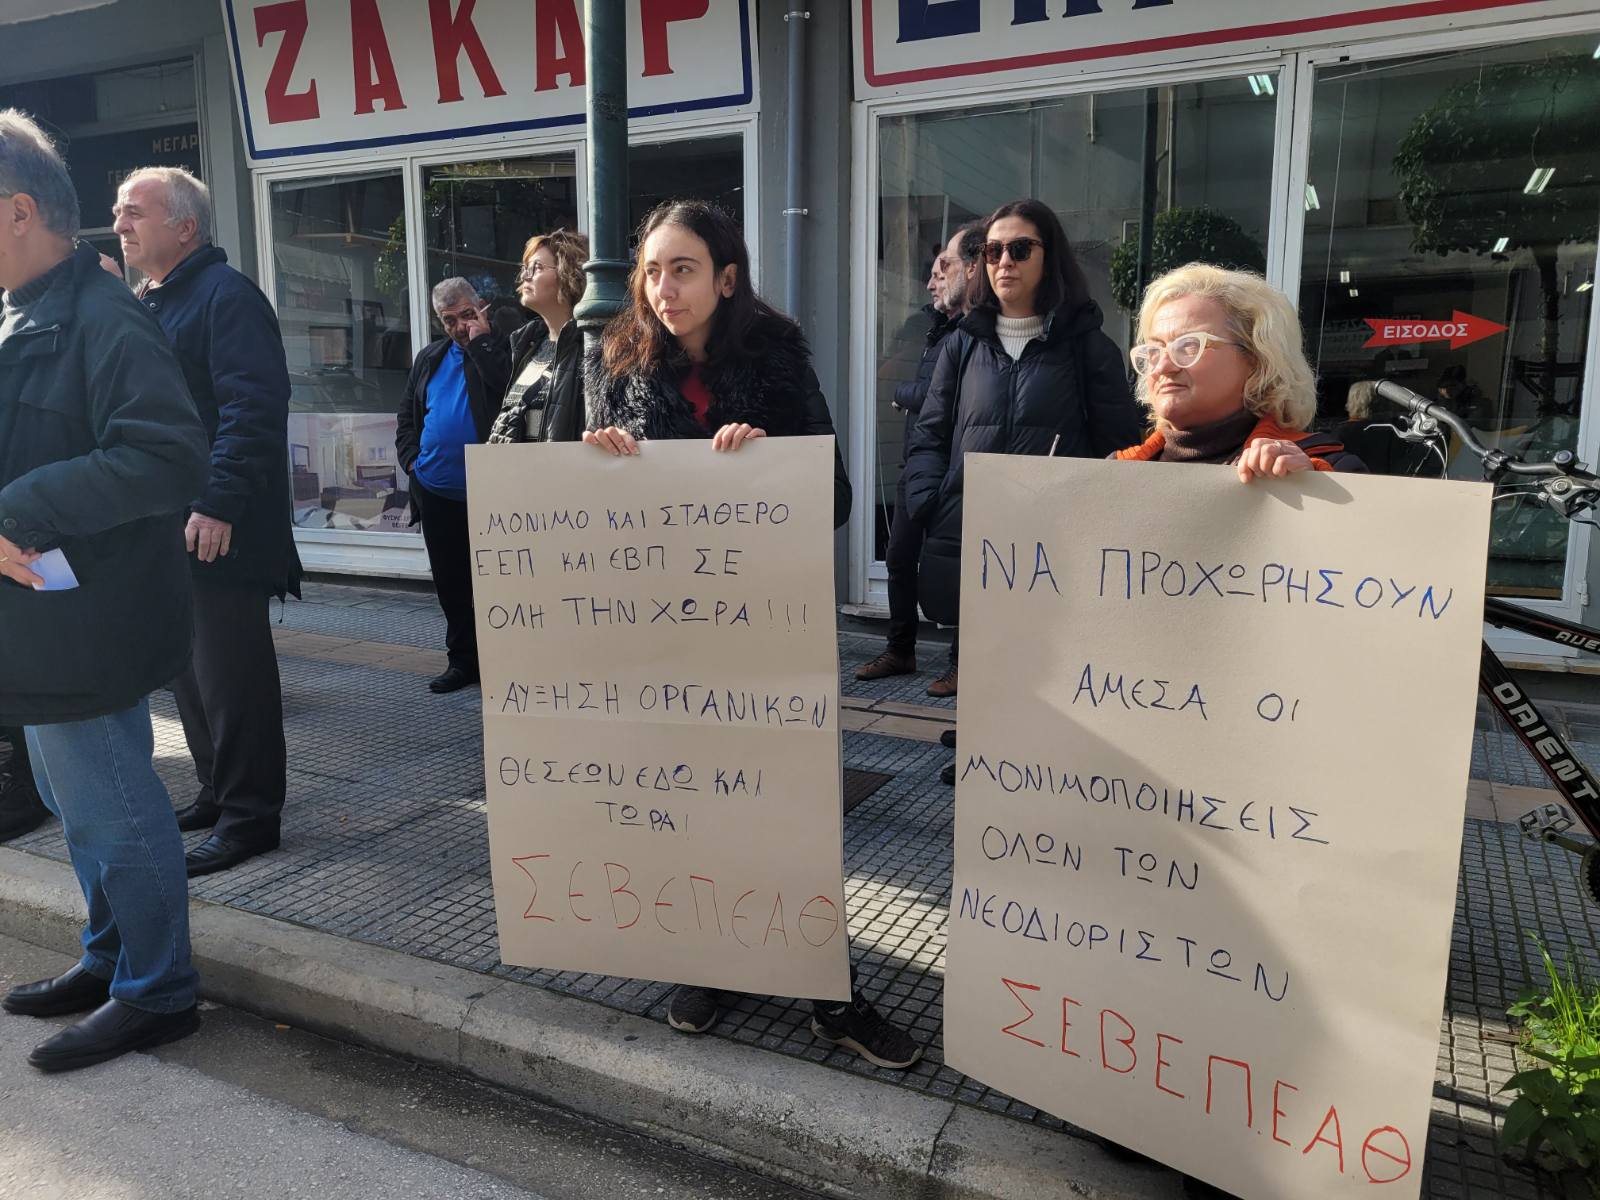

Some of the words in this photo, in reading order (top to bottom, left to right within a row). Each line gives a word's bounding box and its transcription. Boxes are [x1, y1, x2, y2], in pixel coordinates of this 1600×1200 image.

[1383, 323, 1469, 339] ΕΙΣΟΔΟΣ
[606, 508, 646, 531] ΚΑΙ
[660, 501, 790, 527] ΣΤΑΘΕΡΟ
[475, 548, 534, 577] ΕΕΠ
[562, 551, 596, 574] ΚΑΙ
[609, 545, 666, 571] ΕΒΠ
[693, 548, 744, 575] ΣΕ
[981, 538, 1061, 595] ΝΑ
[1099, 548, 1454, 620] ΠΡΟΧΩΡΗΣΟΥΝ
[487, 602, 545, 630] ΟΛΗ
[561, 597, 637, 627] ΤΗΝ
[639, 684, 828, 729] ΟΡΓΑΝΙΚΩΝ
[1072, 663, 1209, 721] ΑΜΕΣΑ
[1256, 692, 1300, 722] ΟΙ
[1492, 681, 1599, 800] ORIENT
[499, 756, 626, 787] ΘΕΣΕΩΝ
[636, 763, 699, 792] ΕΔΩ
[714, 767, 763, 797] ΚΑΙ
[960, 754, 1330, 845] ΜΟΝΙΜΟΠΟΙΗΣΕΙΣ
[981, 825, 1082, 871] ΟΛΩΝ
[1113, 846, 1199, 891] ΤΩΝ
